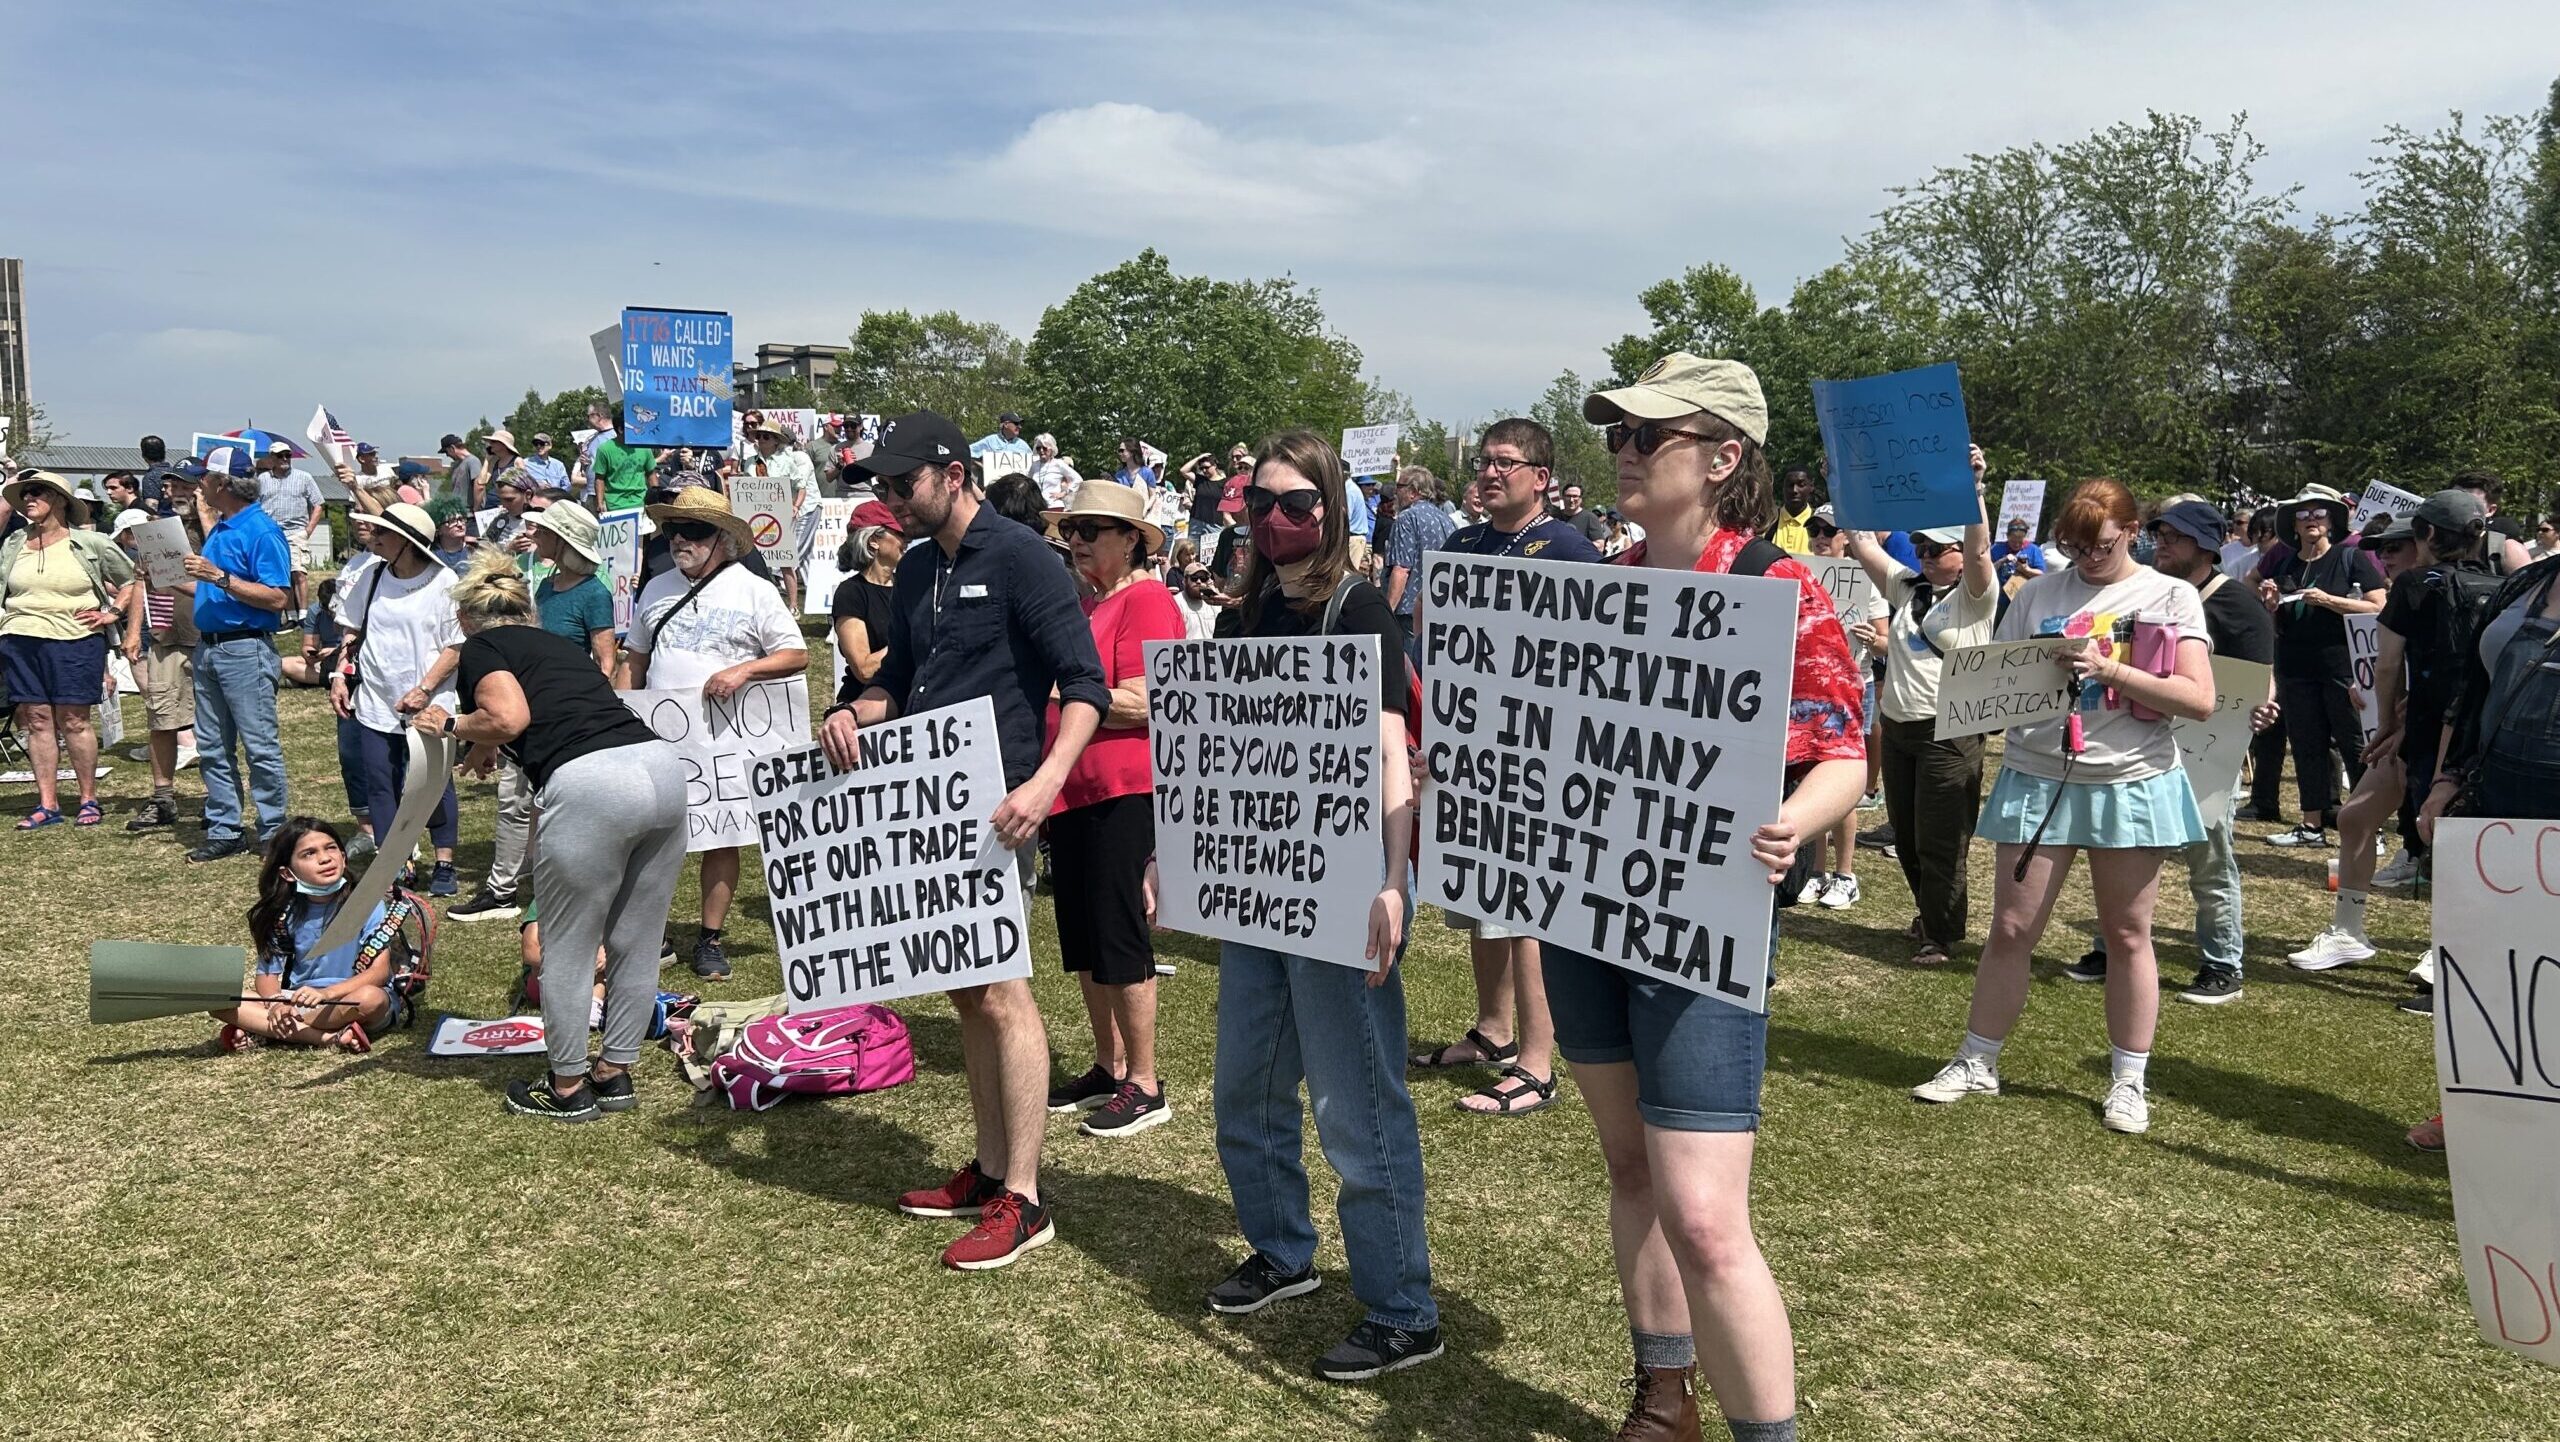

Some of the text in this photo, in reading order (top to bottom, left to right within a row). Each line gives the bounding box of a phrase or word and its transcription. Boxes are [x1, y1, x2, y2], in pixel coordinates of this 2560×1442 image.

[628, 315, 670, 342] 1776
[626, 343, 695, 368] IT WANTS
[624, 368, 709, 394] ITS TYRANT
[1902, 387, 1955, 415] has
[670, 395, 717, 417] BACK
[767, 411, 800, 424] MAKE
[1351, 427, 1388, 440] JUSTICE
[1887, 434, 1948, 468] place
[735, 480, 784, 494] feeling
[1869, 472, 1927, 499] HERE
[2365, 486, 2389, 504] DUE
[754, 504, 773, 512] 1792
[2355, 507, 2369, 522] IS
[760, 550, 794, 561] KINGS
[1429, 561, 1746, 642] GRIEVANCE 18:
[1153, 640, 1369, 687] GRIEVANCE 19:
[1427, 623, 1762, 723] FOR DEPRIVING
[1951, 650, 1985, 676] NO
[1991, 675, 2018, 690] IN
[708, 678, 803, 741] NOT
[1150, 688, 1368, 731] FOR TRANSPORTING
[1948, 689, 2064, 728] AMERICA!
[751, 715, 972, 797] GRIENCE 16:
[1431, 679, 1721, 793] US IN MANY
[1155, 729, 1372, 788] US BEYOND SEAS
[757, 770, 970, 853] FOR CUTTING
[1155, 783, 1370, 838] TO BE TRIED FOR
[1428, 741, 1735, 867] CASES OF THE
[768, 819, 978, 900] OFF OUR TRADE
[1193, 830, 1325, 884] PRETENDED
[1435, 789, 1686, 909] BENEFIT OF
[776, 867, 1005, 949] WITH ALL PARTS
[1198, 882, 1318, 939] OFFENCES
[1441, 852, 1750, 999] JURY TRIAL
[788, 915, 1020, 1002] OF THE WORLD
[468, 1028, 541, 1042] STARTS
